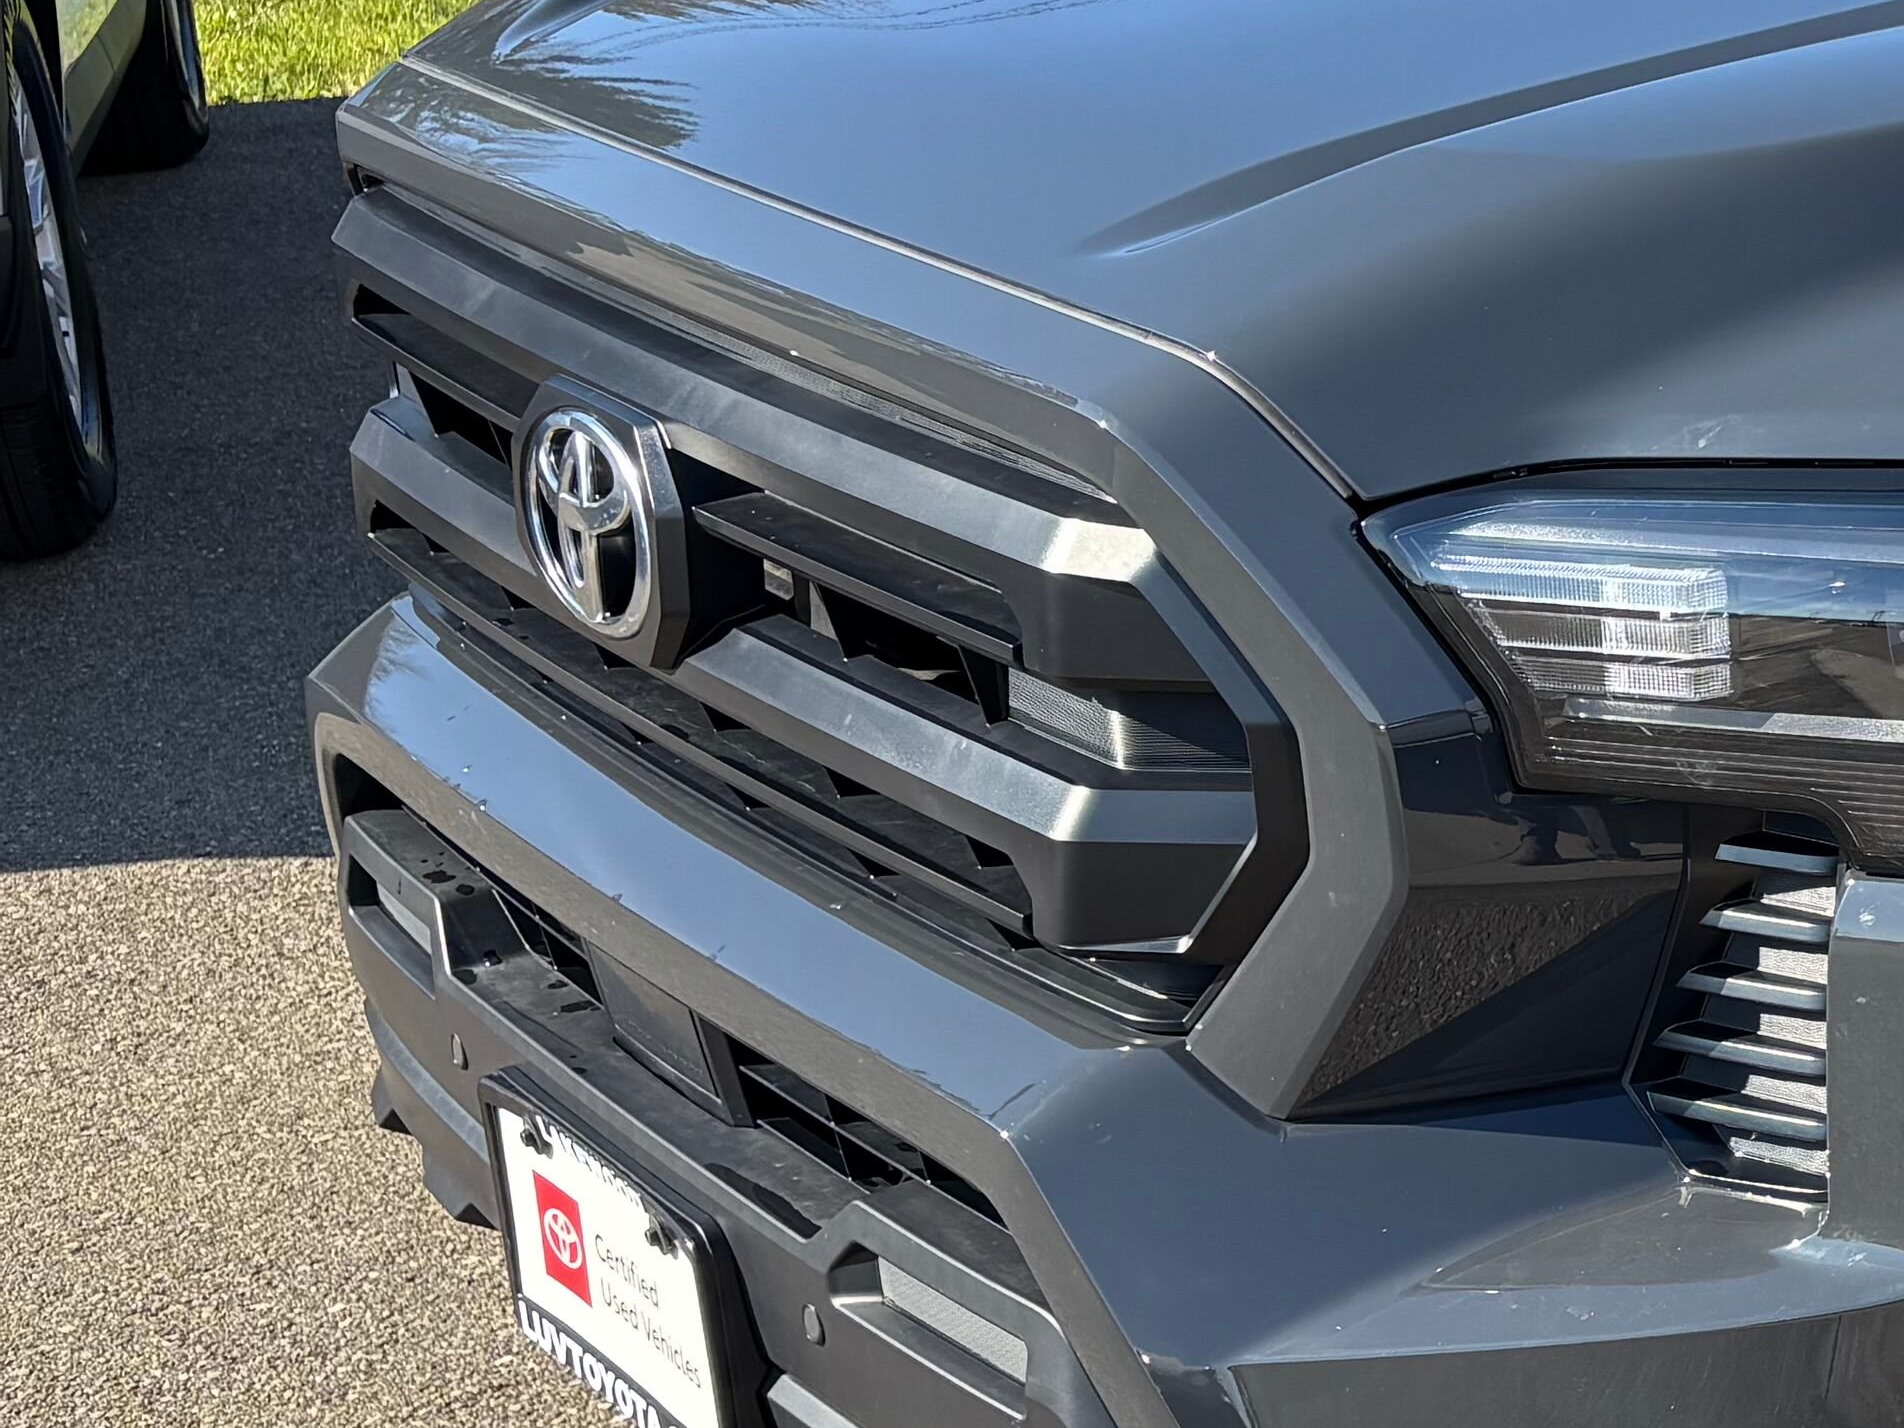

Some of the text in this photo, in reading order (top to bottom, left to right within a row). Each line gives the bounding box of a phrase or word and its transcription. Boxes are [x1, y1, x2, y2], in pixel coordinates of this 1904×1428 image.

[595, 1234, 660, 1310] Certified
[600, 1276, 701, 1389] Used Vehicles
